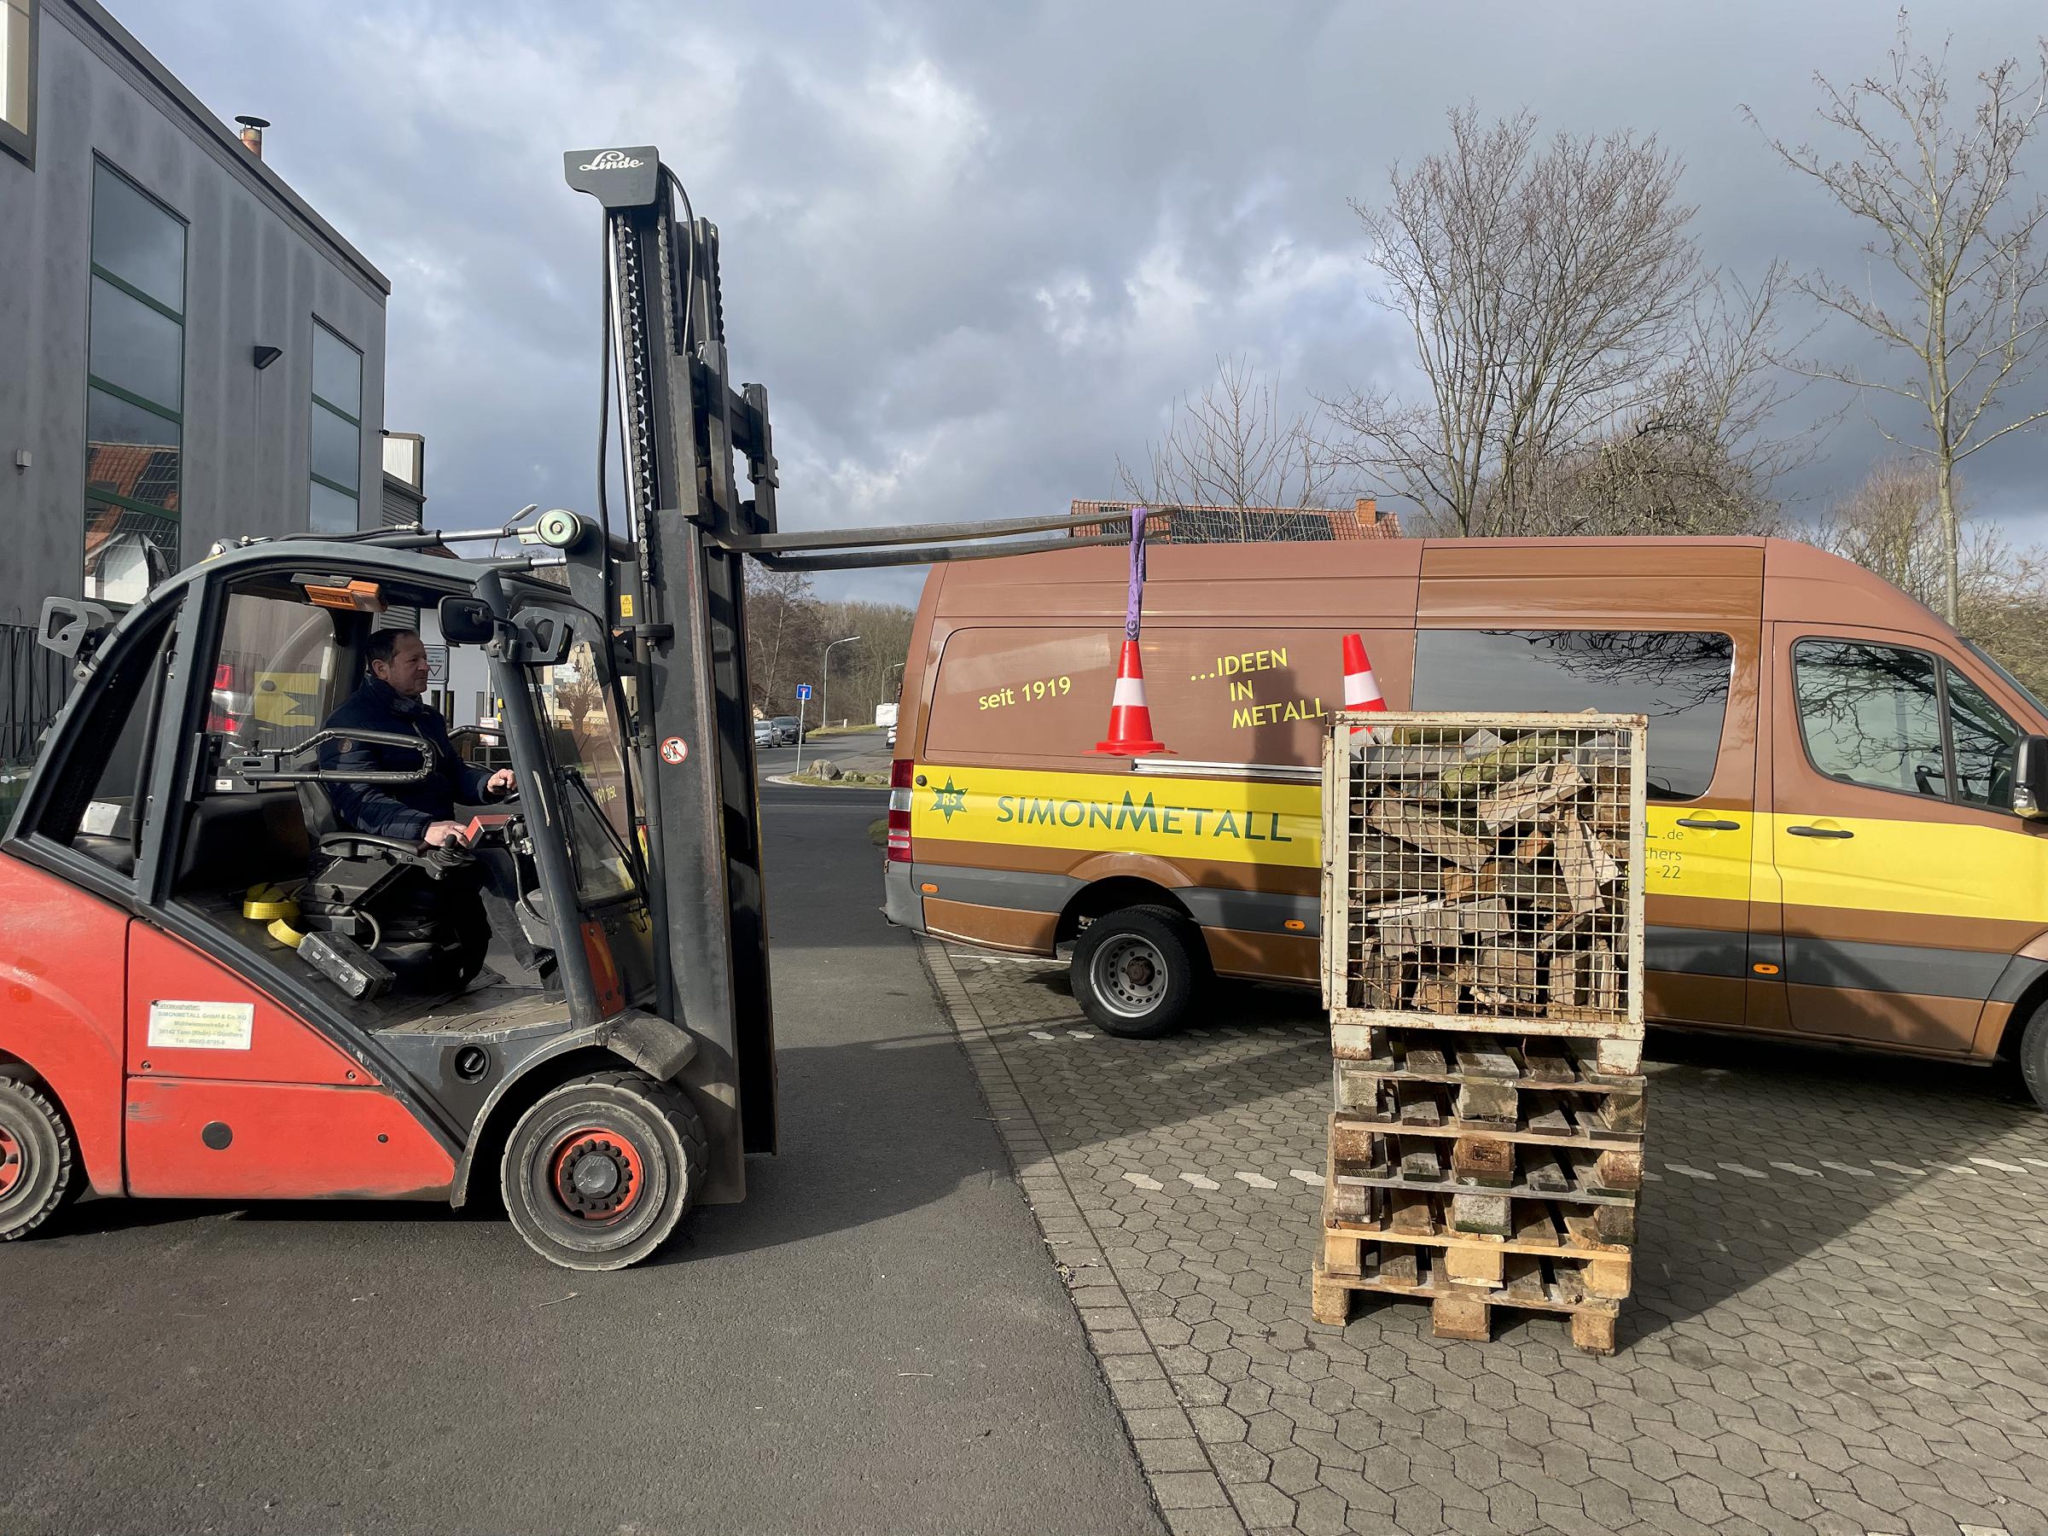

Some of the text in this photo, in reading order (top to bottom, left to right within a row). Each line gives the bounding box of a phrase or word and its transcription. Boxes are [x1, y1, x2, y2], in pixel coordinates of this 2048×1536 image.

[579, 150, 644, 171] Linde
[978, 676, 1072, 711] seit 1919
[1229, 679, 1255, 703] IN
[1232, 697, 1329, 730] METALL
[941, 792, 958, 806] RS
